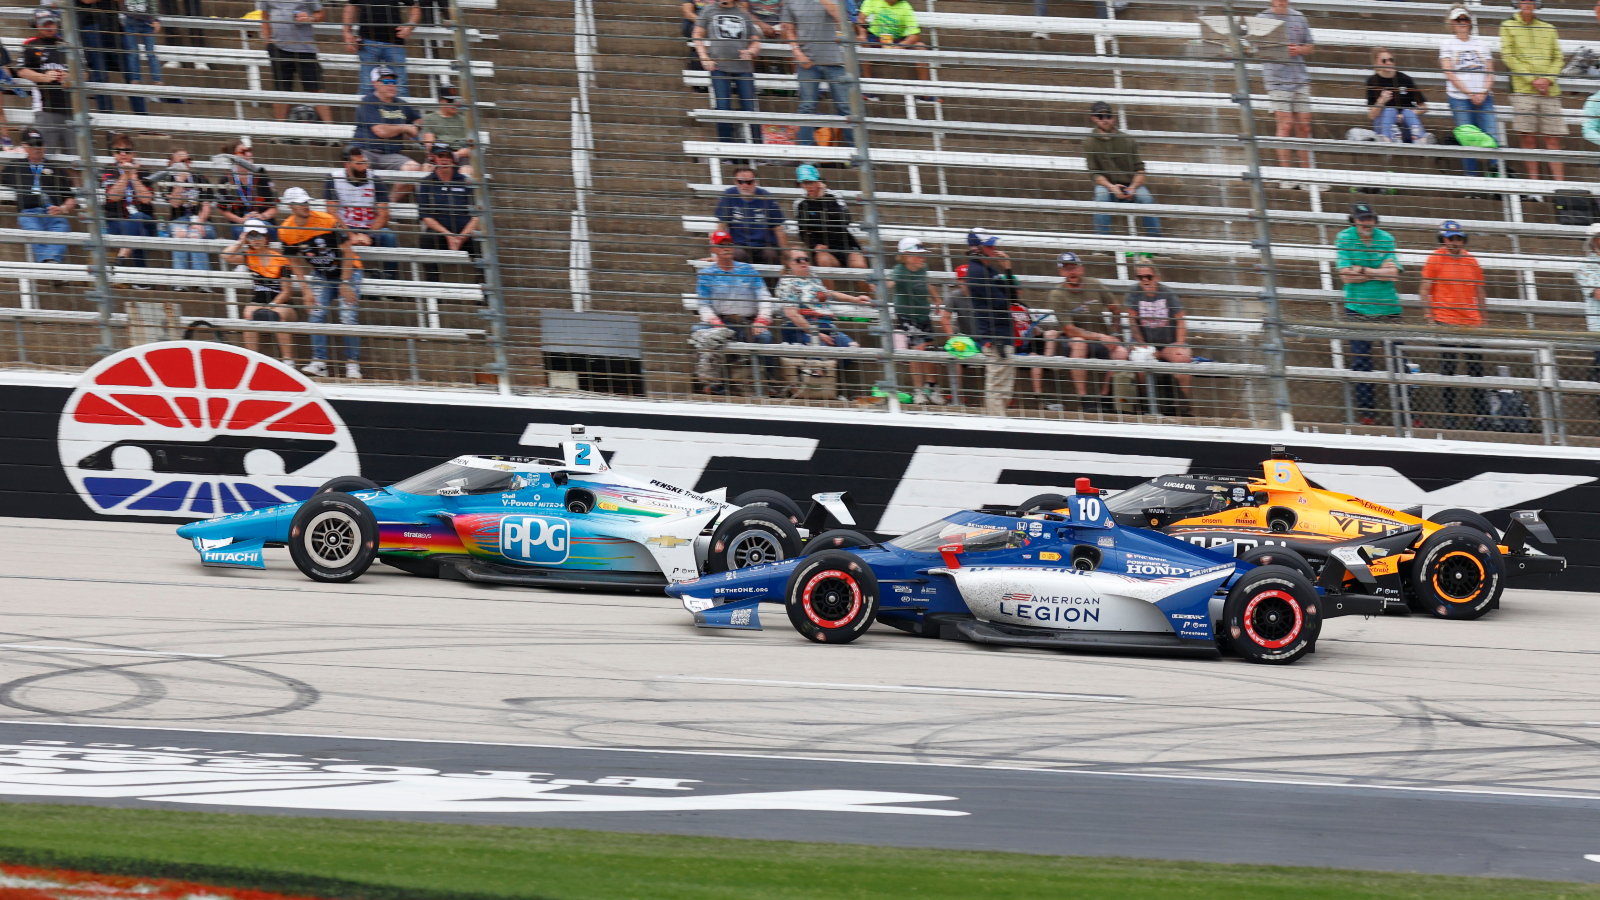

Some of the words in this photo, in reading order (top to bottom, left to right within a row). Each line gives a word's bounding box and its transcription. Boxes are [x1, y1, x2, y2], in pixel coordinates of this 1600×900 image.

[575, 443, 590, 466] 2
[1274, 462, 1290, 483] 5
[650, 479, 683, 494] PENSKE
[684, 490, 704, 502] Truck
[1078, 498, 1100, 521] 10
[1364, 502, 1395, 516] Electrolit
[504, 518, 565, 557] PPG
[205, 552, 258, 562] HITACHI
[1031, 596, 1100, 604] AMERICAN
[1000, 602, 1100, 622] LEGION
